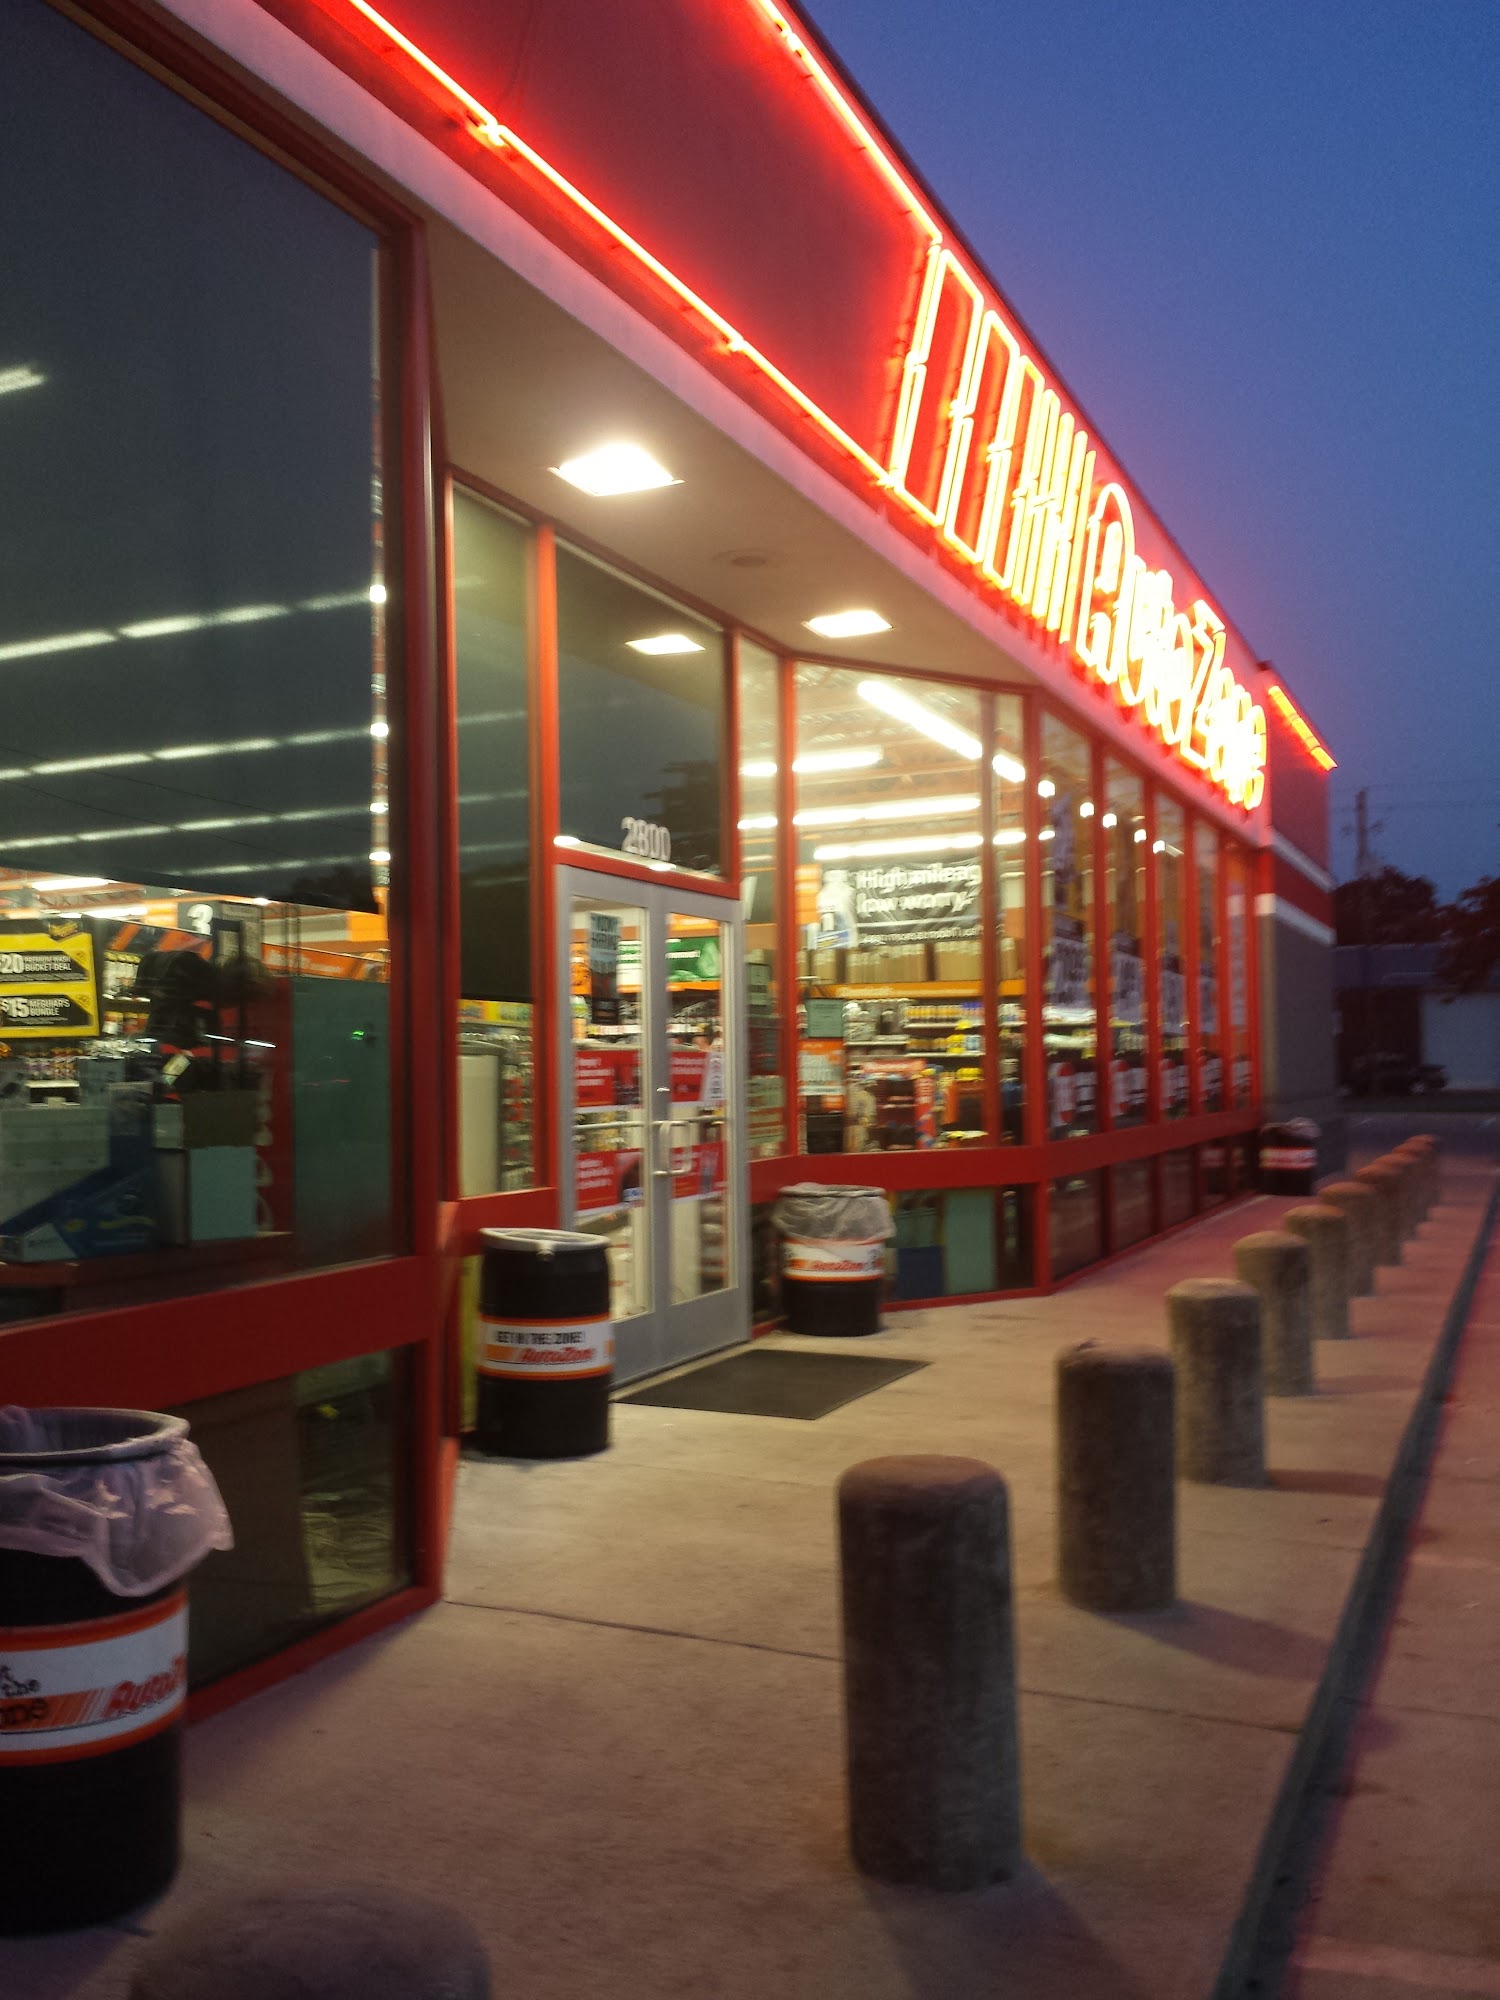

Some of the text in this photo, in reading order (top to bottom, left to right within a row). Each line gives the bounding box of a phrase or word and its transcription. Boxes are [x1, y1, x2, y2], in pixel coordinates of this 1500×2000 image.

[621, 816, 671, 861] 2800
[0, 953, 25, 974] 20
[25, 962, 72, 972] BUCKET DEAL
[1, 997, 30, 1018] $15
[29, 1008, 60, 1017] BUNDLE
